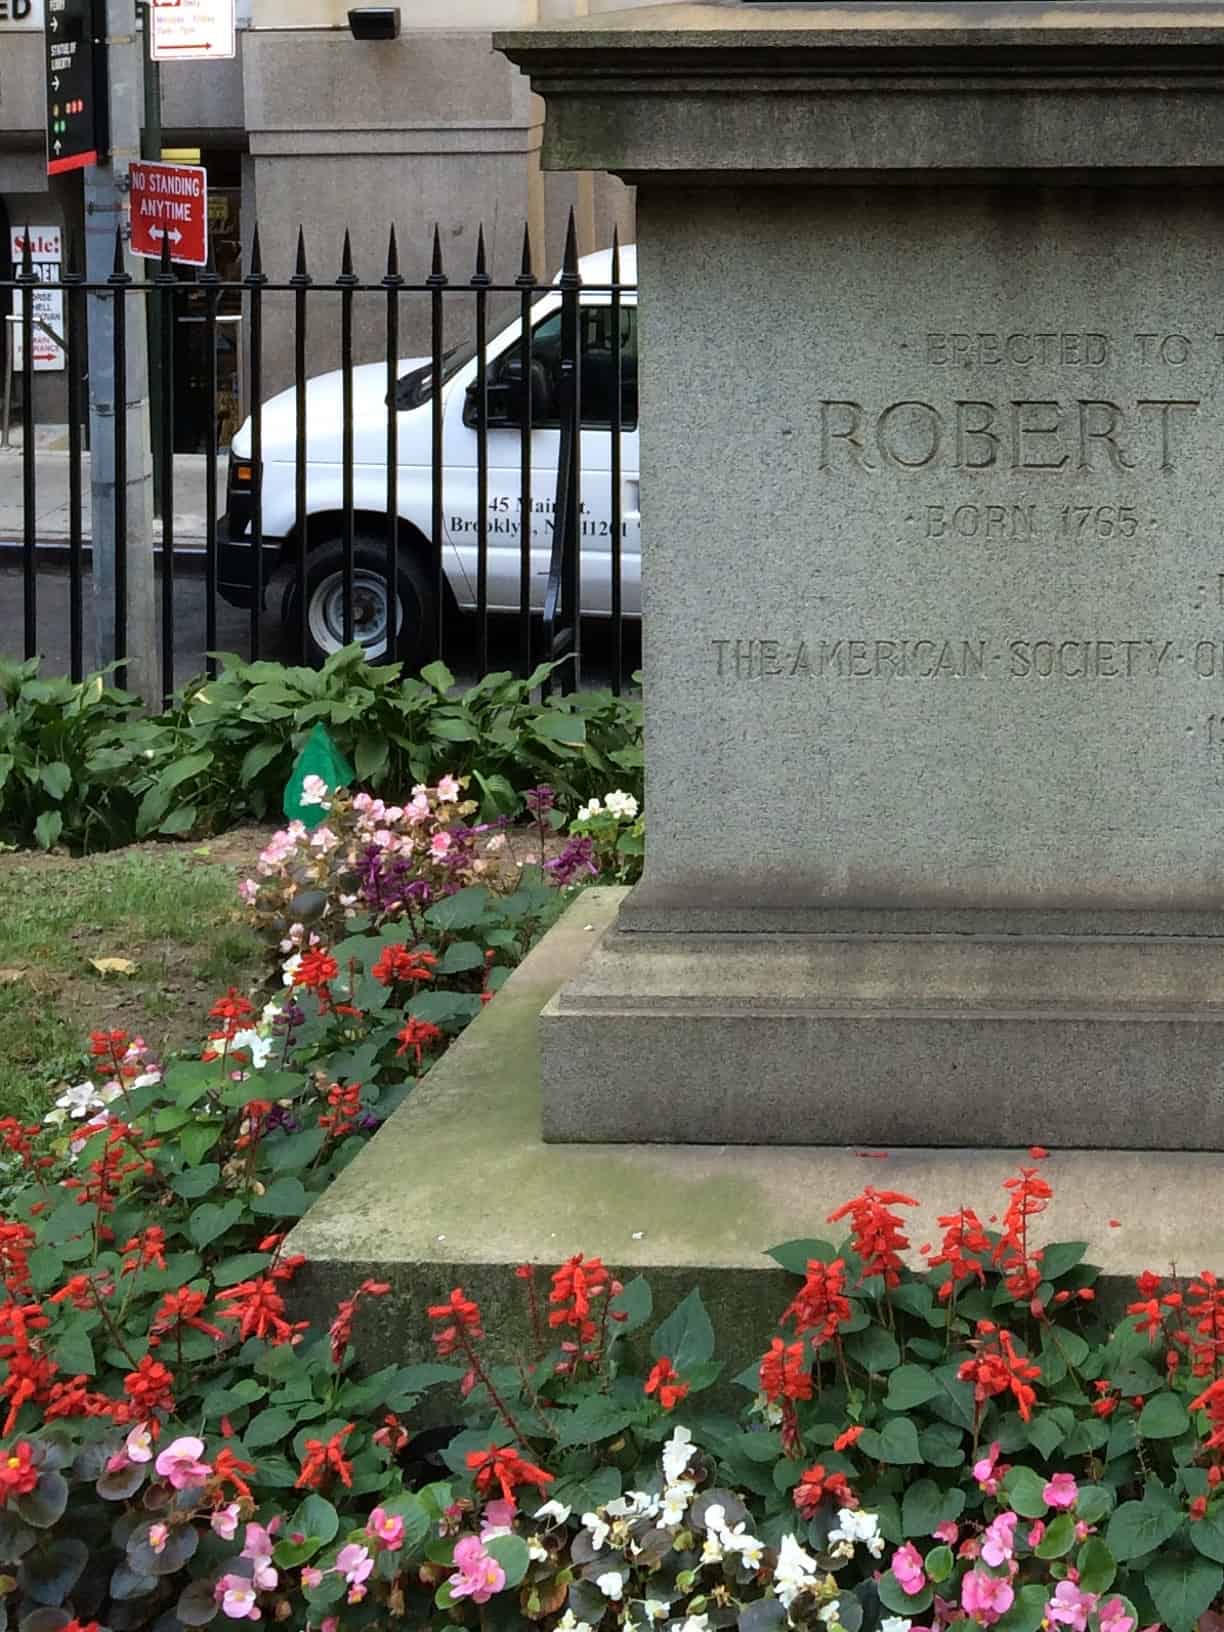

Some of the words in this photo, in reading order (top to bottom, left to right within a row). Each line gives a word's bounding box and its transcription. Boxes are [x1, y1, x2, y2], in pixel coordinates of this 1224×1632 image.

[132, 171, 145, 190] NO
[149, 174, 200, 197] STANDING
[140, 198, 192, 222] ANYTIME
[926, 332, 1110, 367] ERECTED
[1134, 332, 1194, 367] TO
[815, 399, 1200, 473] ROBERT
[488, 497, 509, 513] 45
[451, 516, 538, 538] Brokly,
[582, 521, 628, 537] 1121
[924, 504, 1036, 539] BORN
[1060, 504, 1139, 539] 1765
[711, 639, 783, 678] THE
[787, 639, 987, 680] AMERICAN
[1007, 640, 1172, 680] SOCIETY
